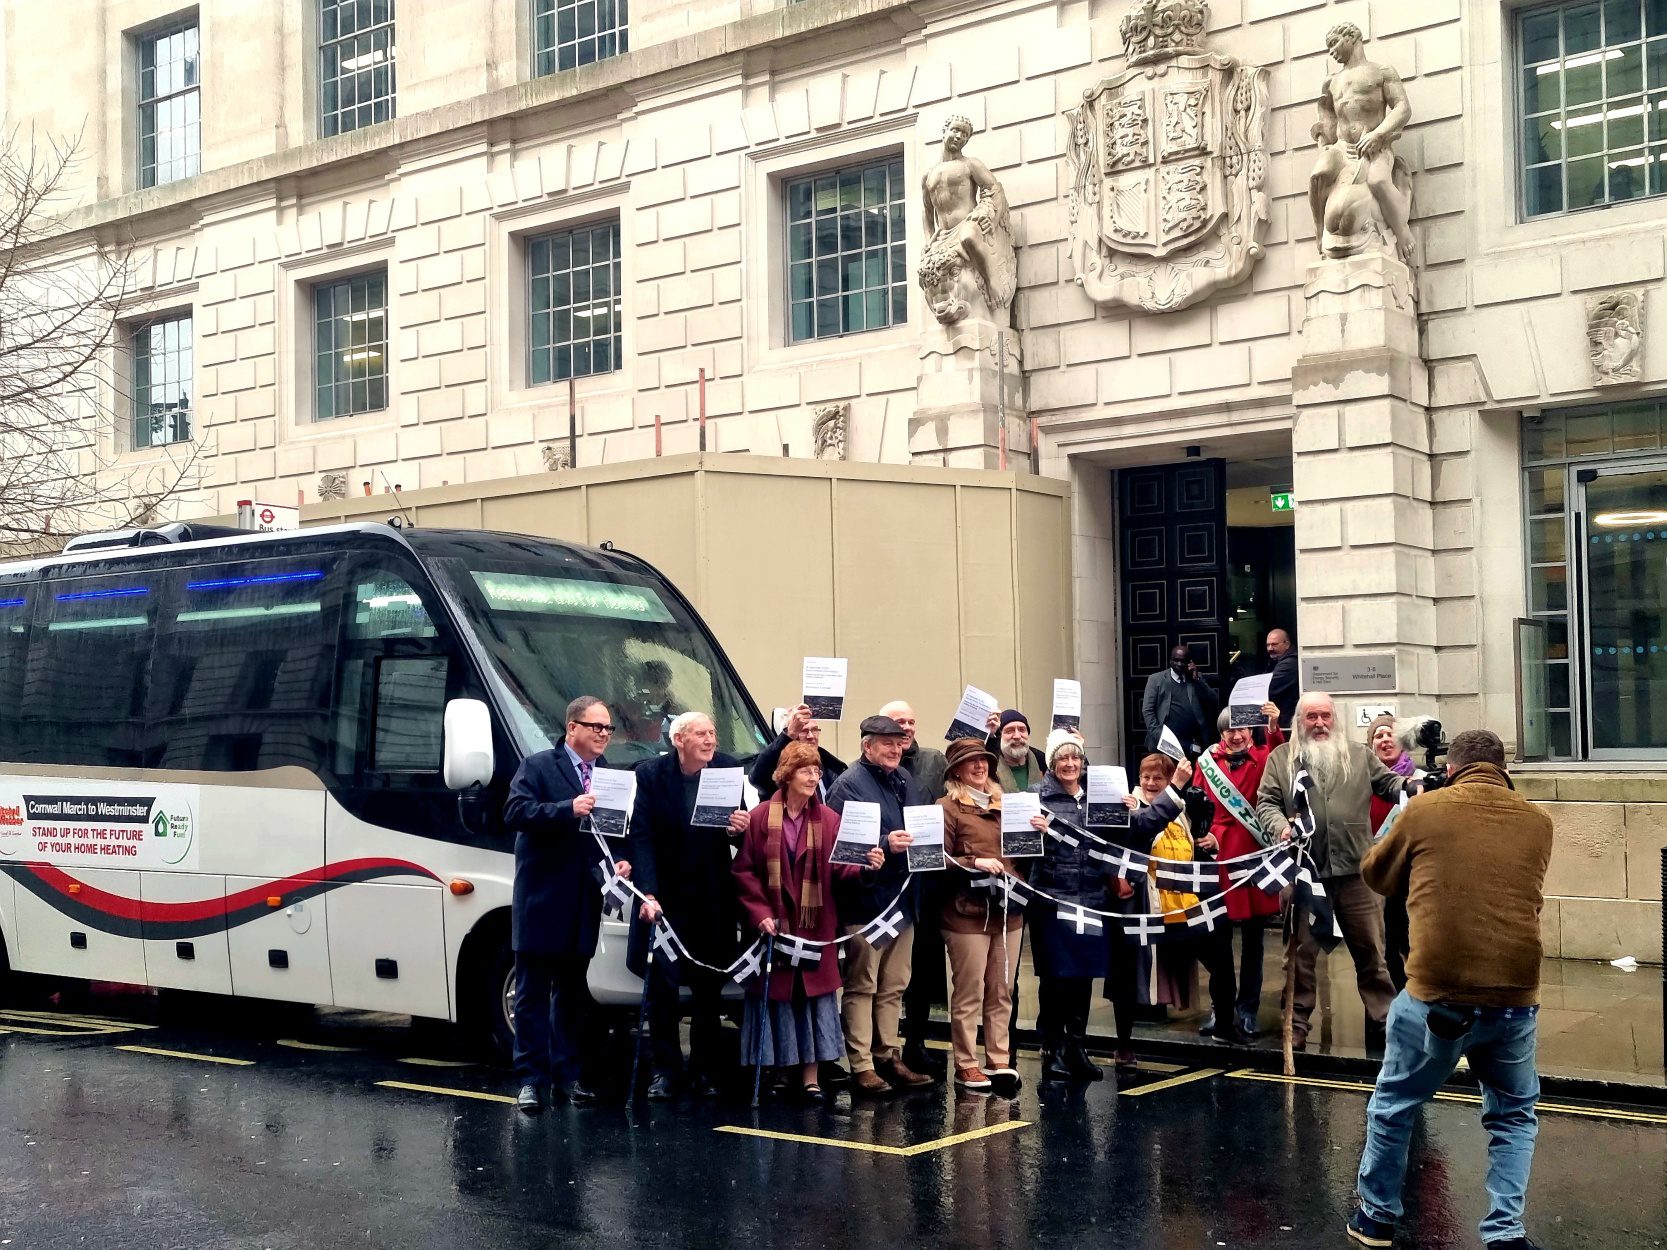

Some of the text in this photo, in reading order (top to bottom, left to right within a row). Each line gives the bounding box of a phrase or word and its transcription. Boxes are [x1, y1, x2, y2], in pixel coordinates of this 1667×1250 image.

[259, 524, 274, 532] Bus
[28, 800, 149, 816] Cornwall March to Westminster
[170, 814, 189, 822] Future
[31, 826, 58, 838] STAND
[59, 827, 71, 839] UP
[72, 828, 89, 840] FOR
[90, 828, 108, 840] THE
[109, 829, 144, 841] FUTURE
[170, 823, 189, 832] Ready
[37, 841, 137, 857] OF YOUR HOME HEATING
